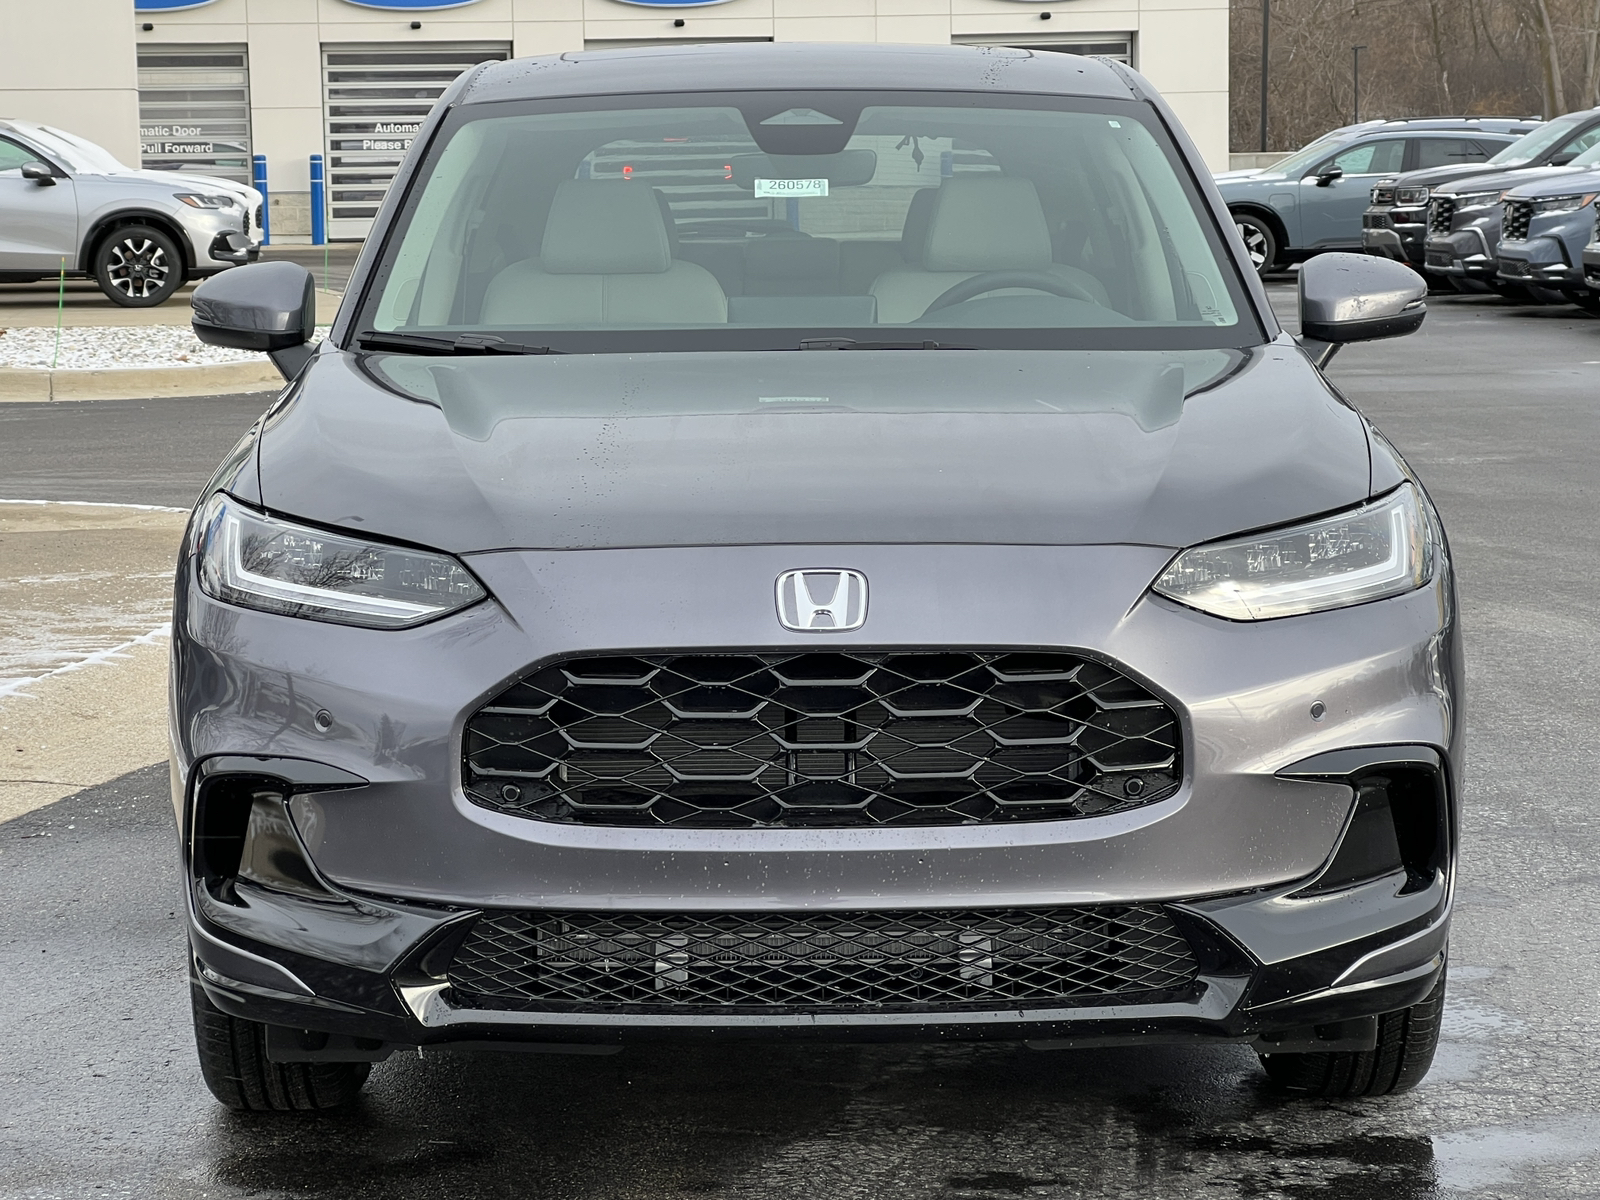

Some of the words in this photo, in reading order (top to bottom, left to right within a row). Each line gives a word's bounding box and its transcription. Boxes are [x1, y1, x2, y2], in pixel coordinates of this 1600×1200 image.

[172, 125, 202, 136] Door
[140, 142, 162, 153] Pull
[164, 142, 214, 153] Forward
[362, 139, 402, 150] Please
[768, 180, 821, 190] 260578
